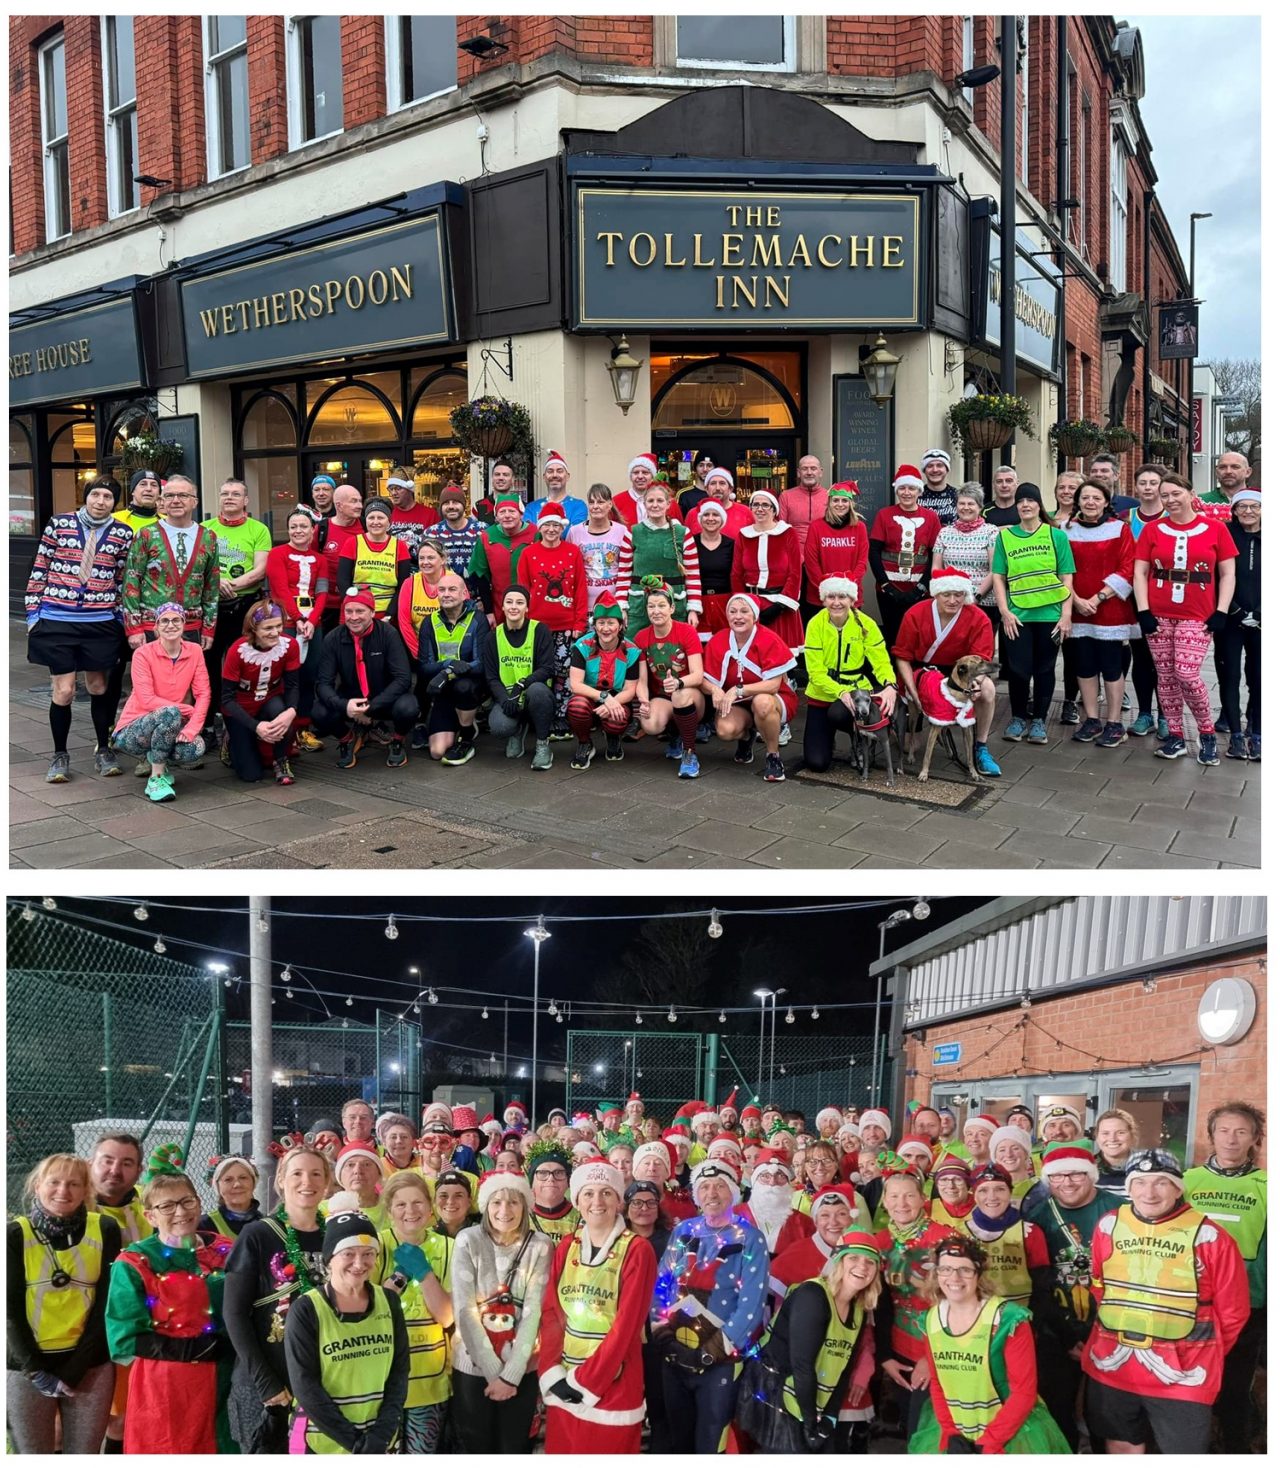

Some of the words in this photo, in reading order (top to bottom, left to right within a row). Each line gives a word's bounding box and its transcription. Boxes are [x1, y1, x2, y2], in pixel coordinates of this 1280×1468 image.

[726, 205, 782, 227] THE
[597, 232, 905, 268] TOLLEMACHE
[715, 275, 791, 308] INN
[199, 264, 413, 338] WETHERSPOON
[36, 338, 91, 372] HOUSE
[847, 390, 871, 400] FOO
[821, 536, 856, 547] SPARKLE
[1008, 544, 1051, 558] GRANTHAM
[357, 559, 395, 570] GRANTHAM
[413, 604, 438, 613] GRANTH
[1192, 1191, 1258, 1207] GRANTHAM
[1197, 1200, 1230, 1209] RUNNING
[1231, 1203, 1251, 1211] CLUB
[1115, 1236, 1186, 1254] GRANTHAM
[991, 1255, 1022, 1265] THAM
[1121, 1248, 1152, 1256] RUNNING
[1154, 1250, 1177, 1259] CLUB
[560, 1284, 614, 1299] GRANTHAM
[322, 1334, 392, 1356] GRANTHAM
[331, 1349, 371, 1363] RUNNING
[372, 1346, 390, 1356] CLUB
[933, 1351, 983, 1365] RANTHAM
